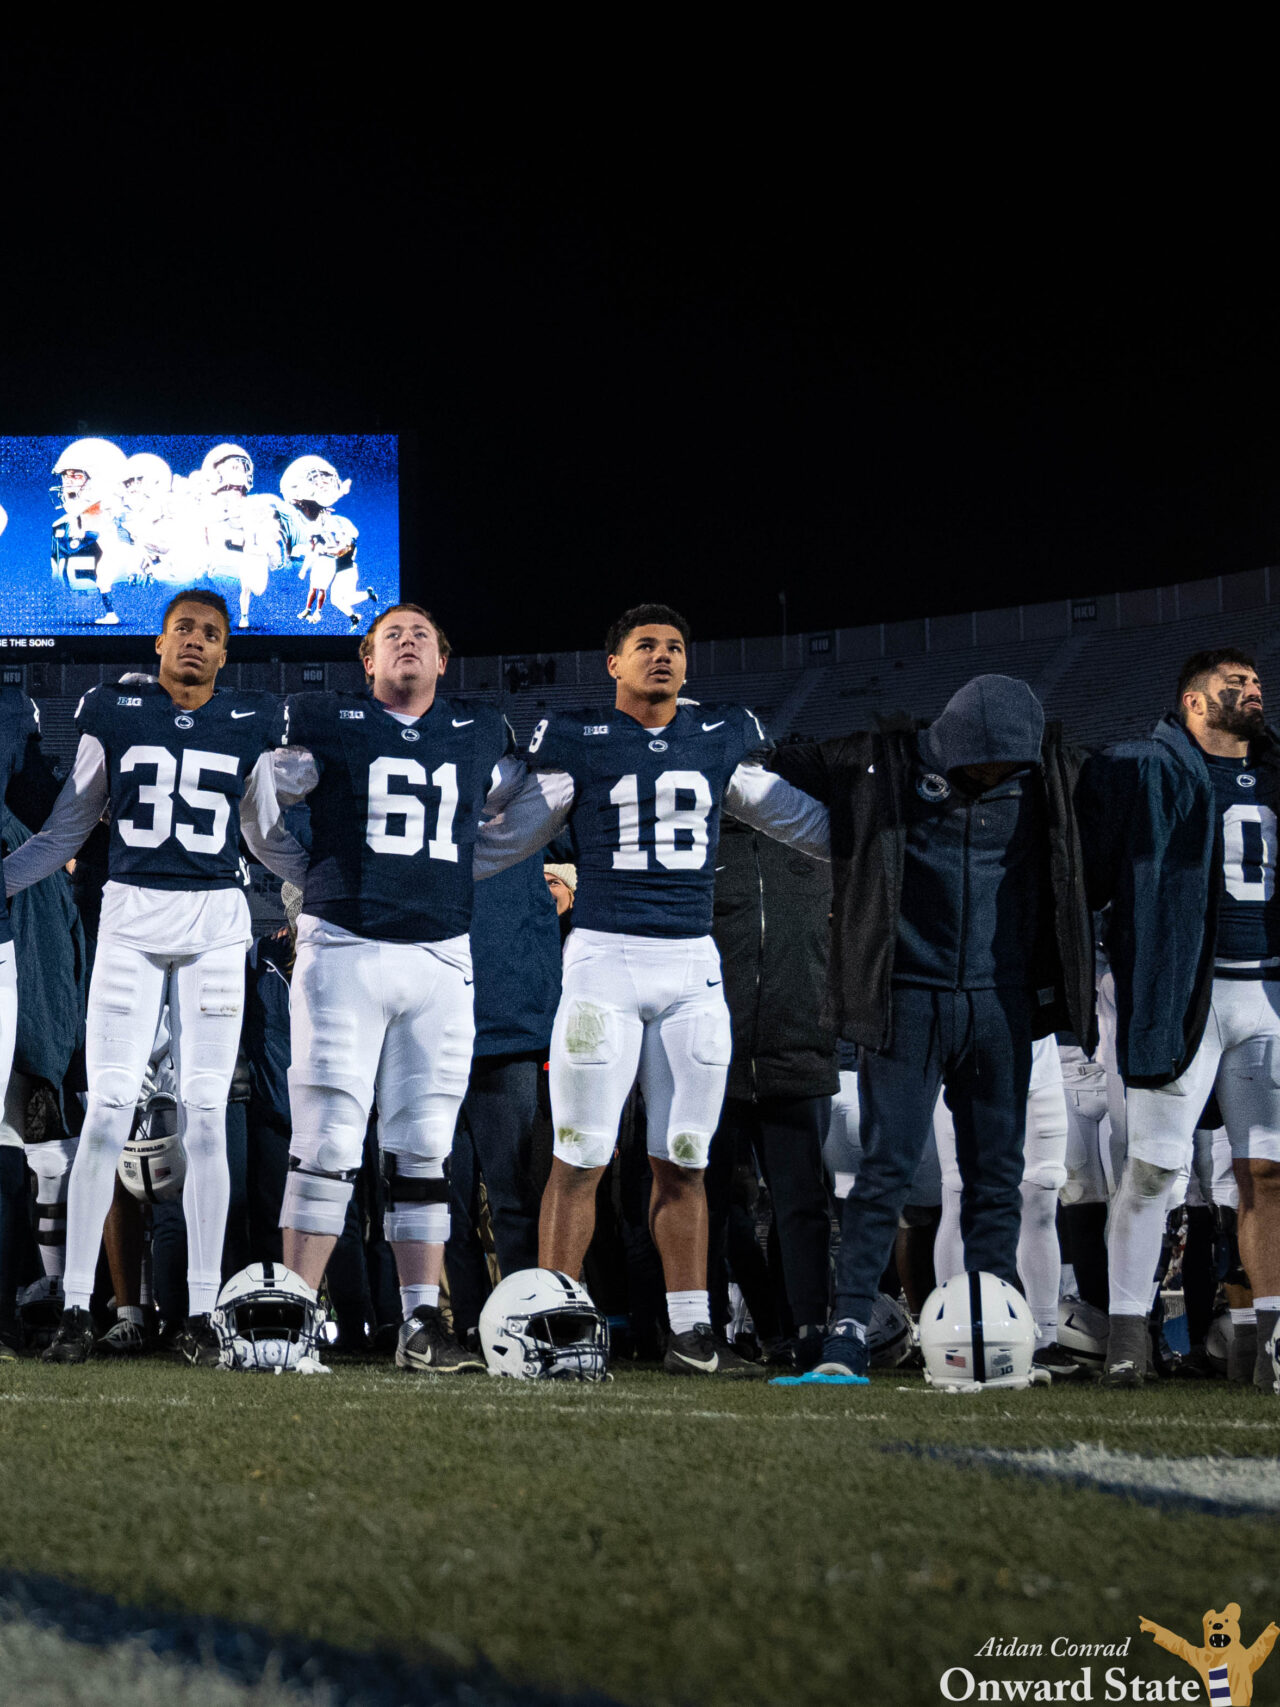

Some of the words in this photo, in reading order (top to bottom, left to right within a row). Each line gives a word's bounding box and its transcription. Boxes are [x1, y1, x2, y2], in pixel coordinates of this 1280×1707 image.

[9, 638, 27, 647] THE
[29, 638, 55, 647] SONG
[117, 745, 240, 855] 35
[366, 756, 459, 863] 61
[610, 770, 713, 870] 18
[1223, 804, 1278, 901] 0
